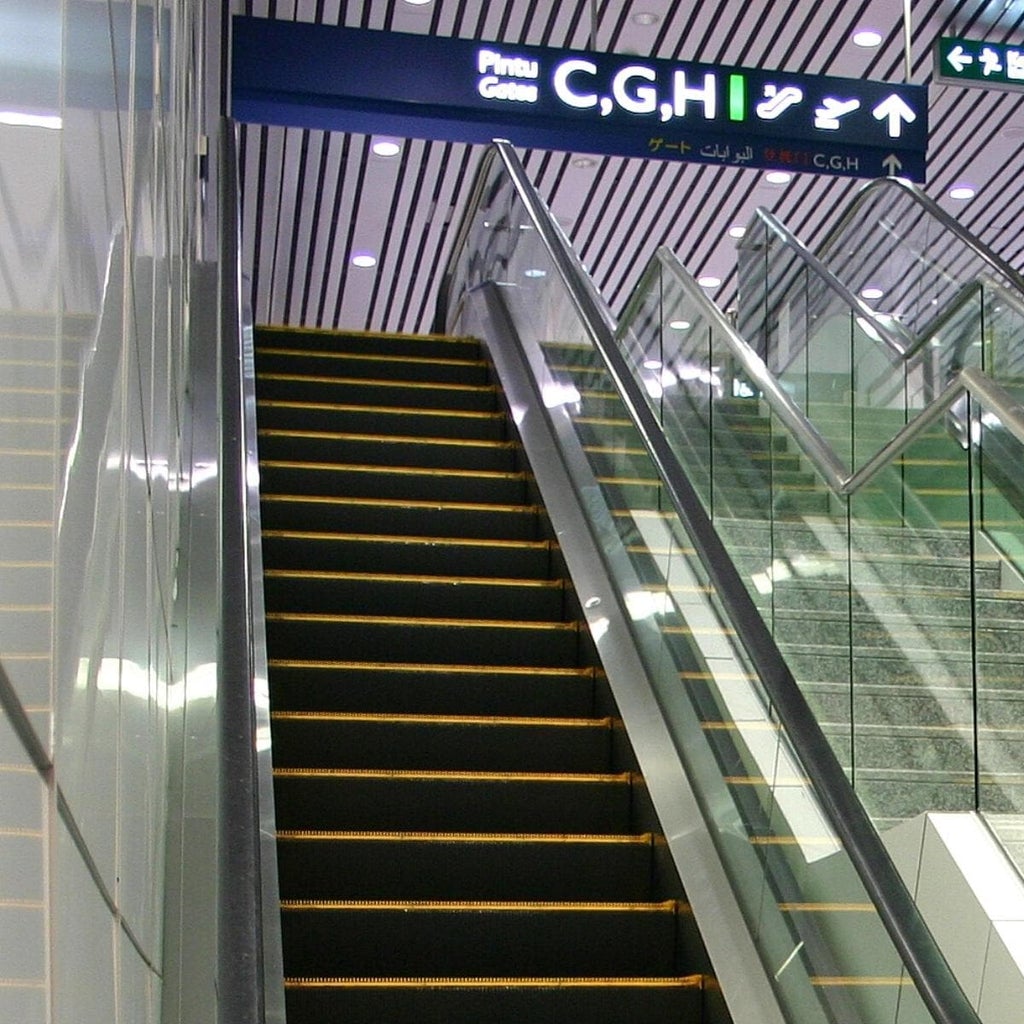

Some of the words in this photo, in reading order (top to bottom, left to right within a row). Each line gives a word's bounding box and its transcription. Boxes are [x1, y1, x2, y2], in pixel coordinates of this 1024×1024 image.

[478, 50, 538, 78] Pintu
[554, 60, 716, 122] C,G,H
[648, 137, 691, 154] ゲート
[813, 154, 860, 171] C,G,H
